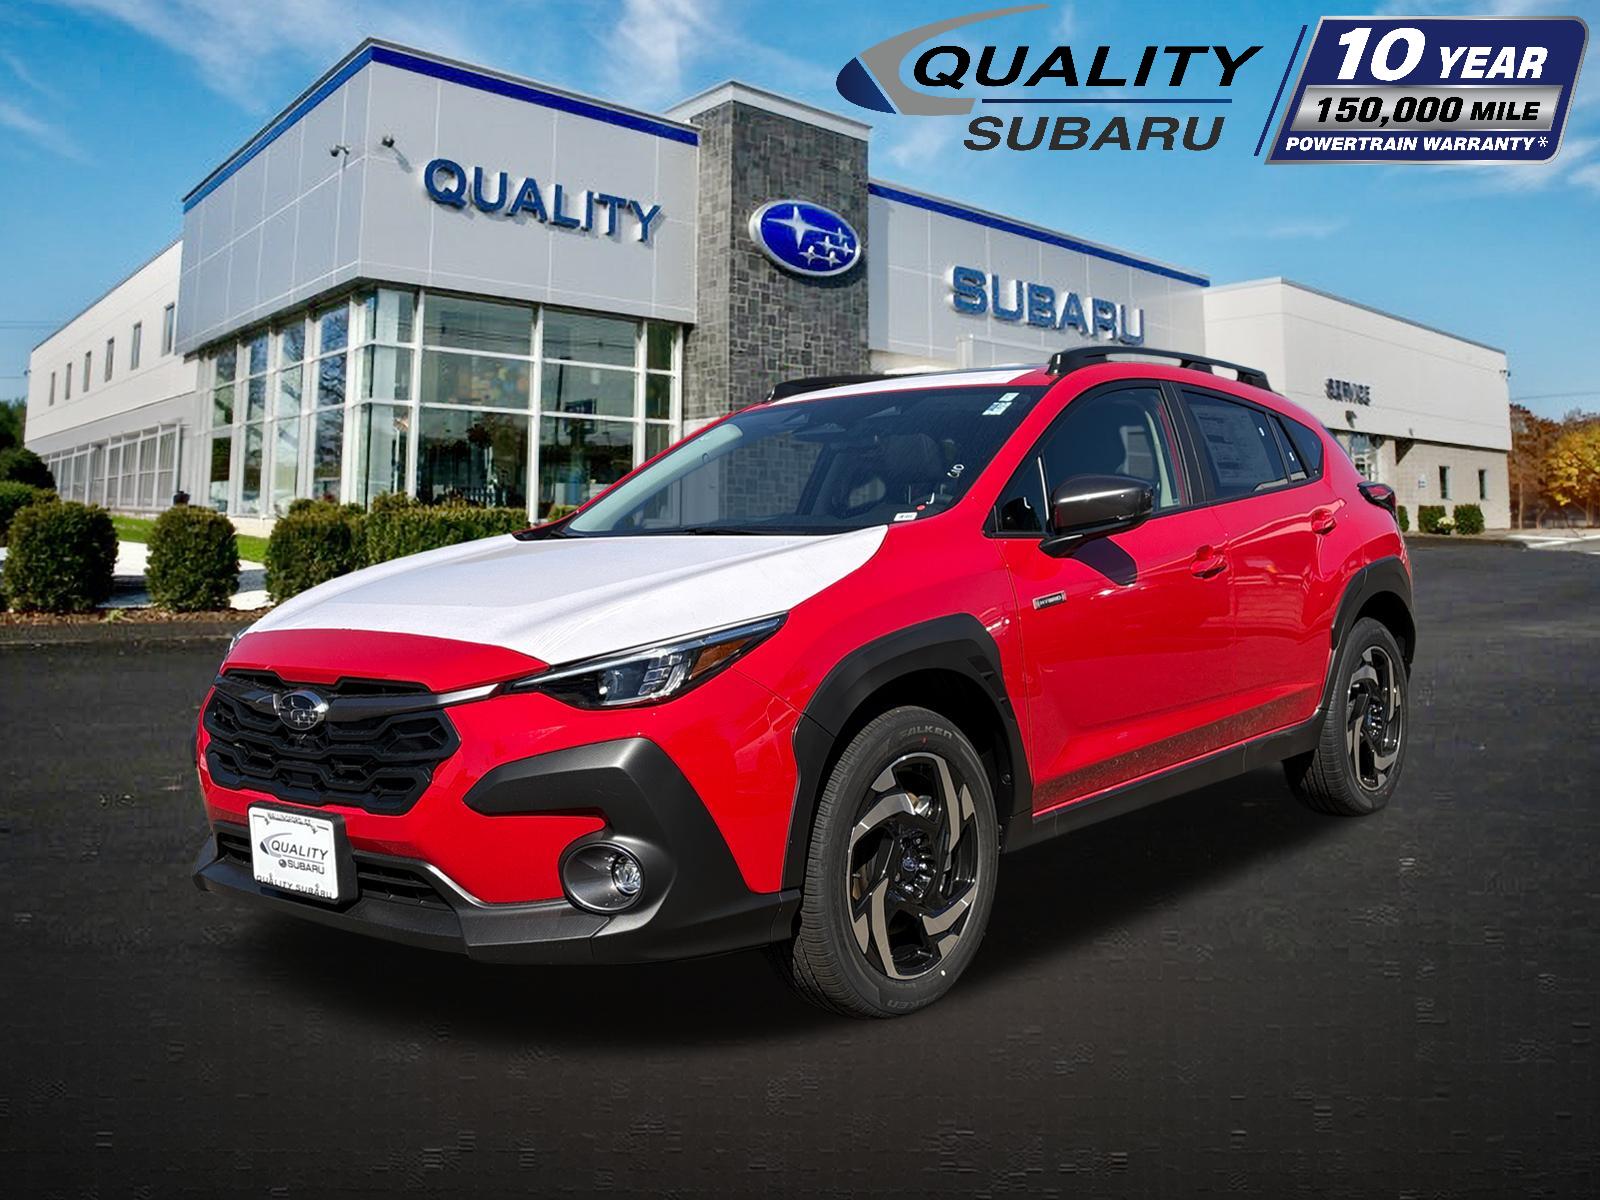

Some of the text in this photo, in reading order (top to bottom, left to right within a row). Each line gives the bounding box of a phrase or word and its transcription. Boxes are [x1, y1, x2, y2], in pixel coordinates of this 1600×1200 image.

[424, 158, 662, 243] QUALITY
[950, 266, 1145, 346] SUBARU
[900, 725, 953, 739] FALKEN
[271, 840, 329, 860] QUALITY
[287, 859, 325, 875] SUBARU
[256, 875, 293, 888] QUALITY
